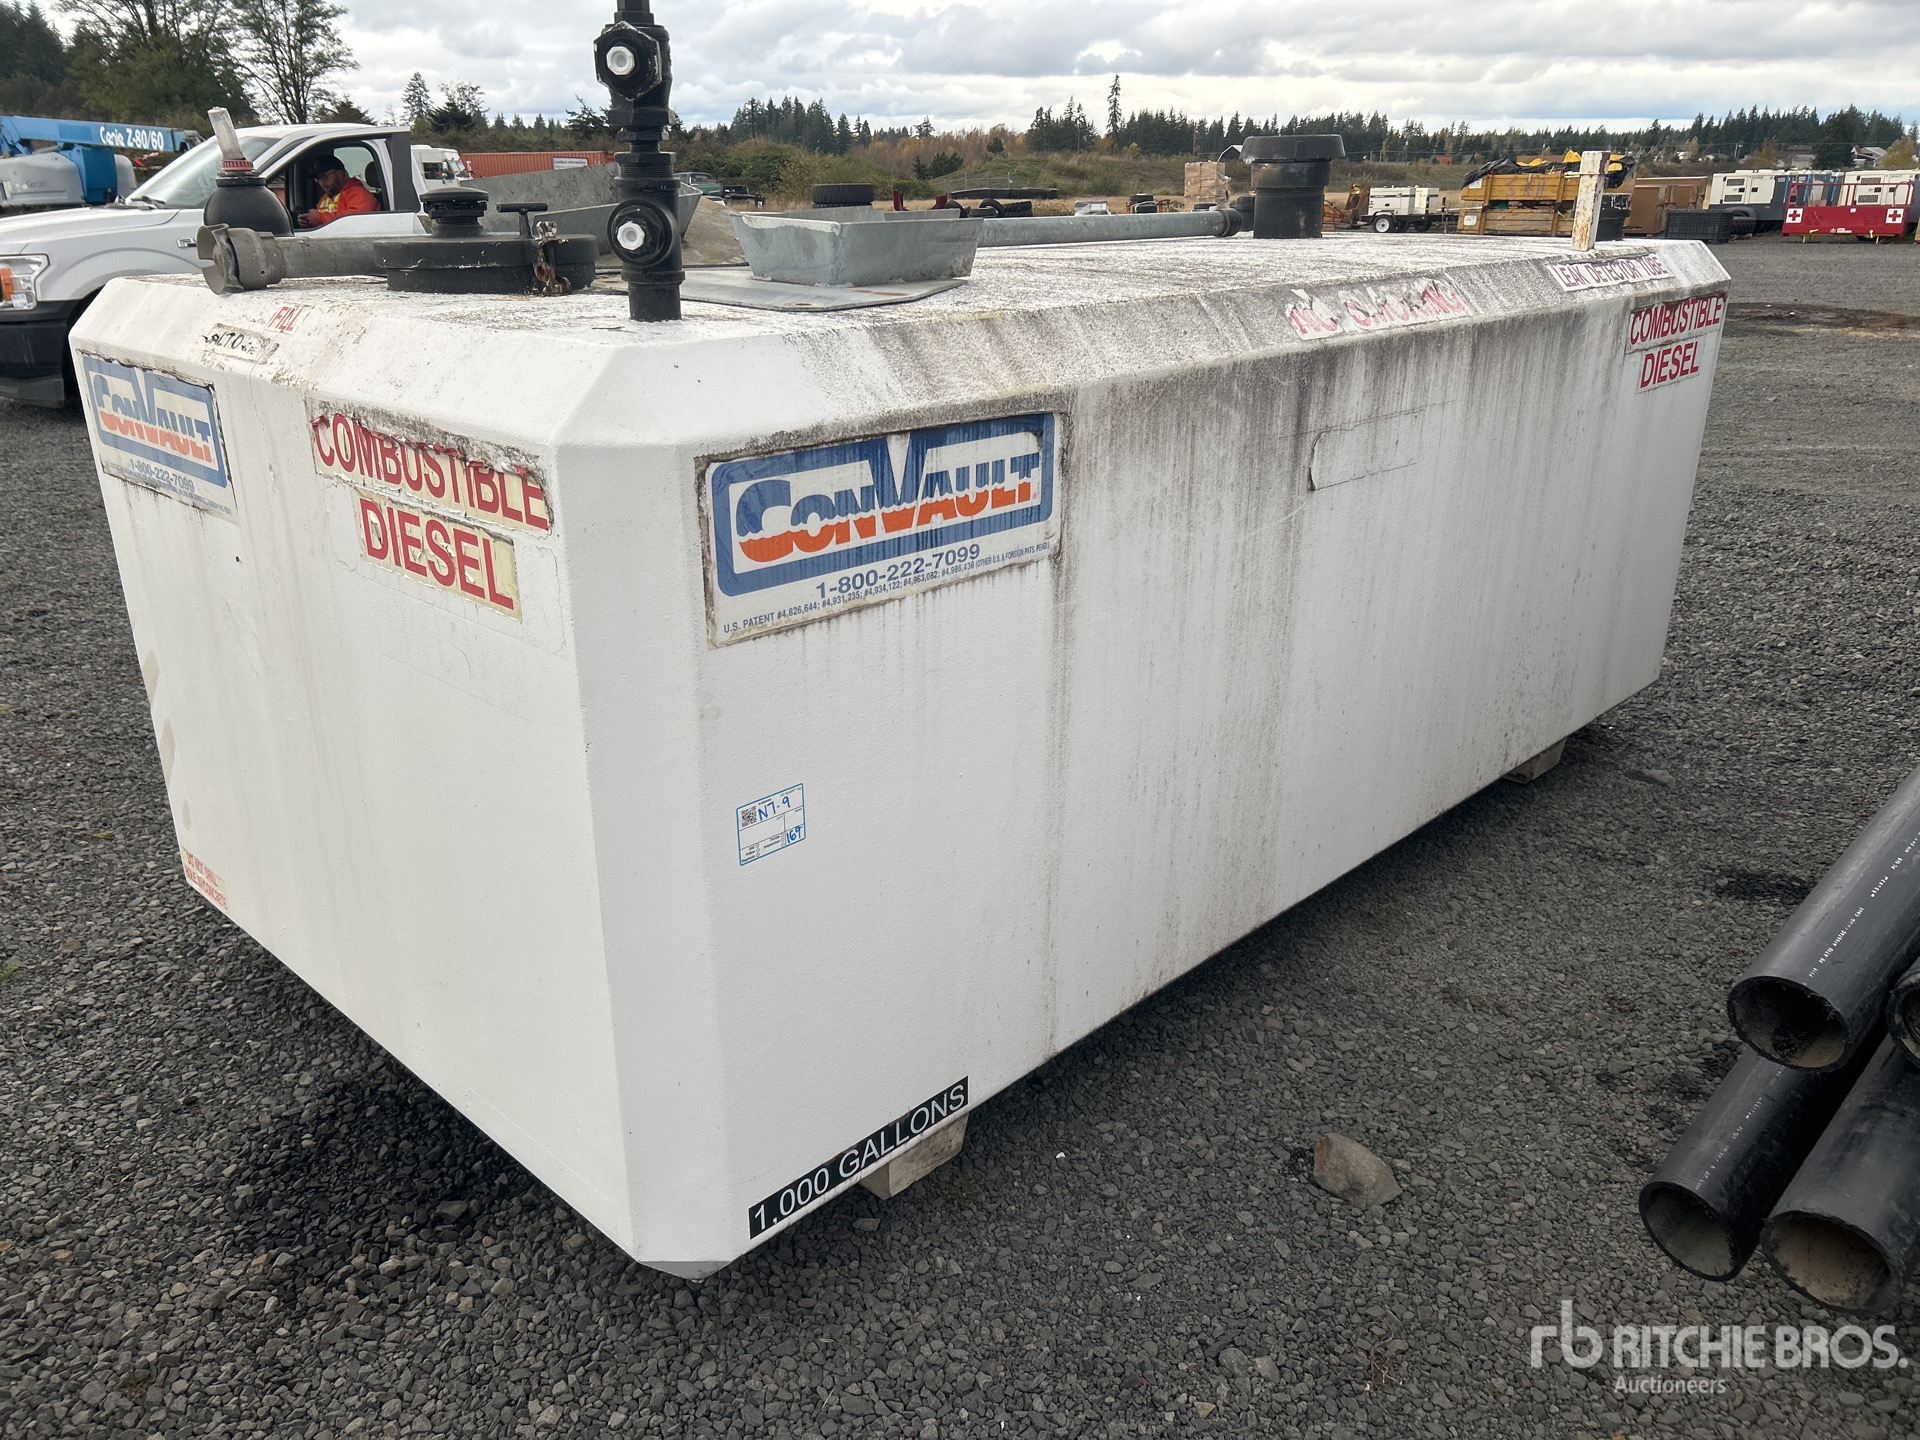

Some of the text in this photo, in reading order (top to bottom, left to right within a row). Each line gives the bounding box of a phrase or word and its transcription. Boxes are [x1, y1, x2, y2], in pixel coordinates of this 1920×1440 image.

[125, 127, 164, 151] Z-80/60
[1552, 254, 1669, 288] LEAK DETECTOR TUBE
[1629, 294, 1725, 346] COMBUSTIBLE
[1640, 341, 1699, 389] DIESEL
[129, 457, 196, 493] 1-800-222-7099
[311, 412, 550, 531] COMBUSTIBLE
[359, 497, 515, 611] DIESEL
[815, 543, 981, 599] 1-800-222-7099
[723, 622, 741, 634] U.S.
[743, 612, 775, 629] PATENT
[776, 601, 820, 620] #4,826,644;
[821, 590, 863, 608] #4,931,235;
[864, 580, 903, 598] #4,934,122;
[1005, 548, 1024, 560] FOREIGN
[754, 1083, 966, 1231] 1,000 GALLONS
